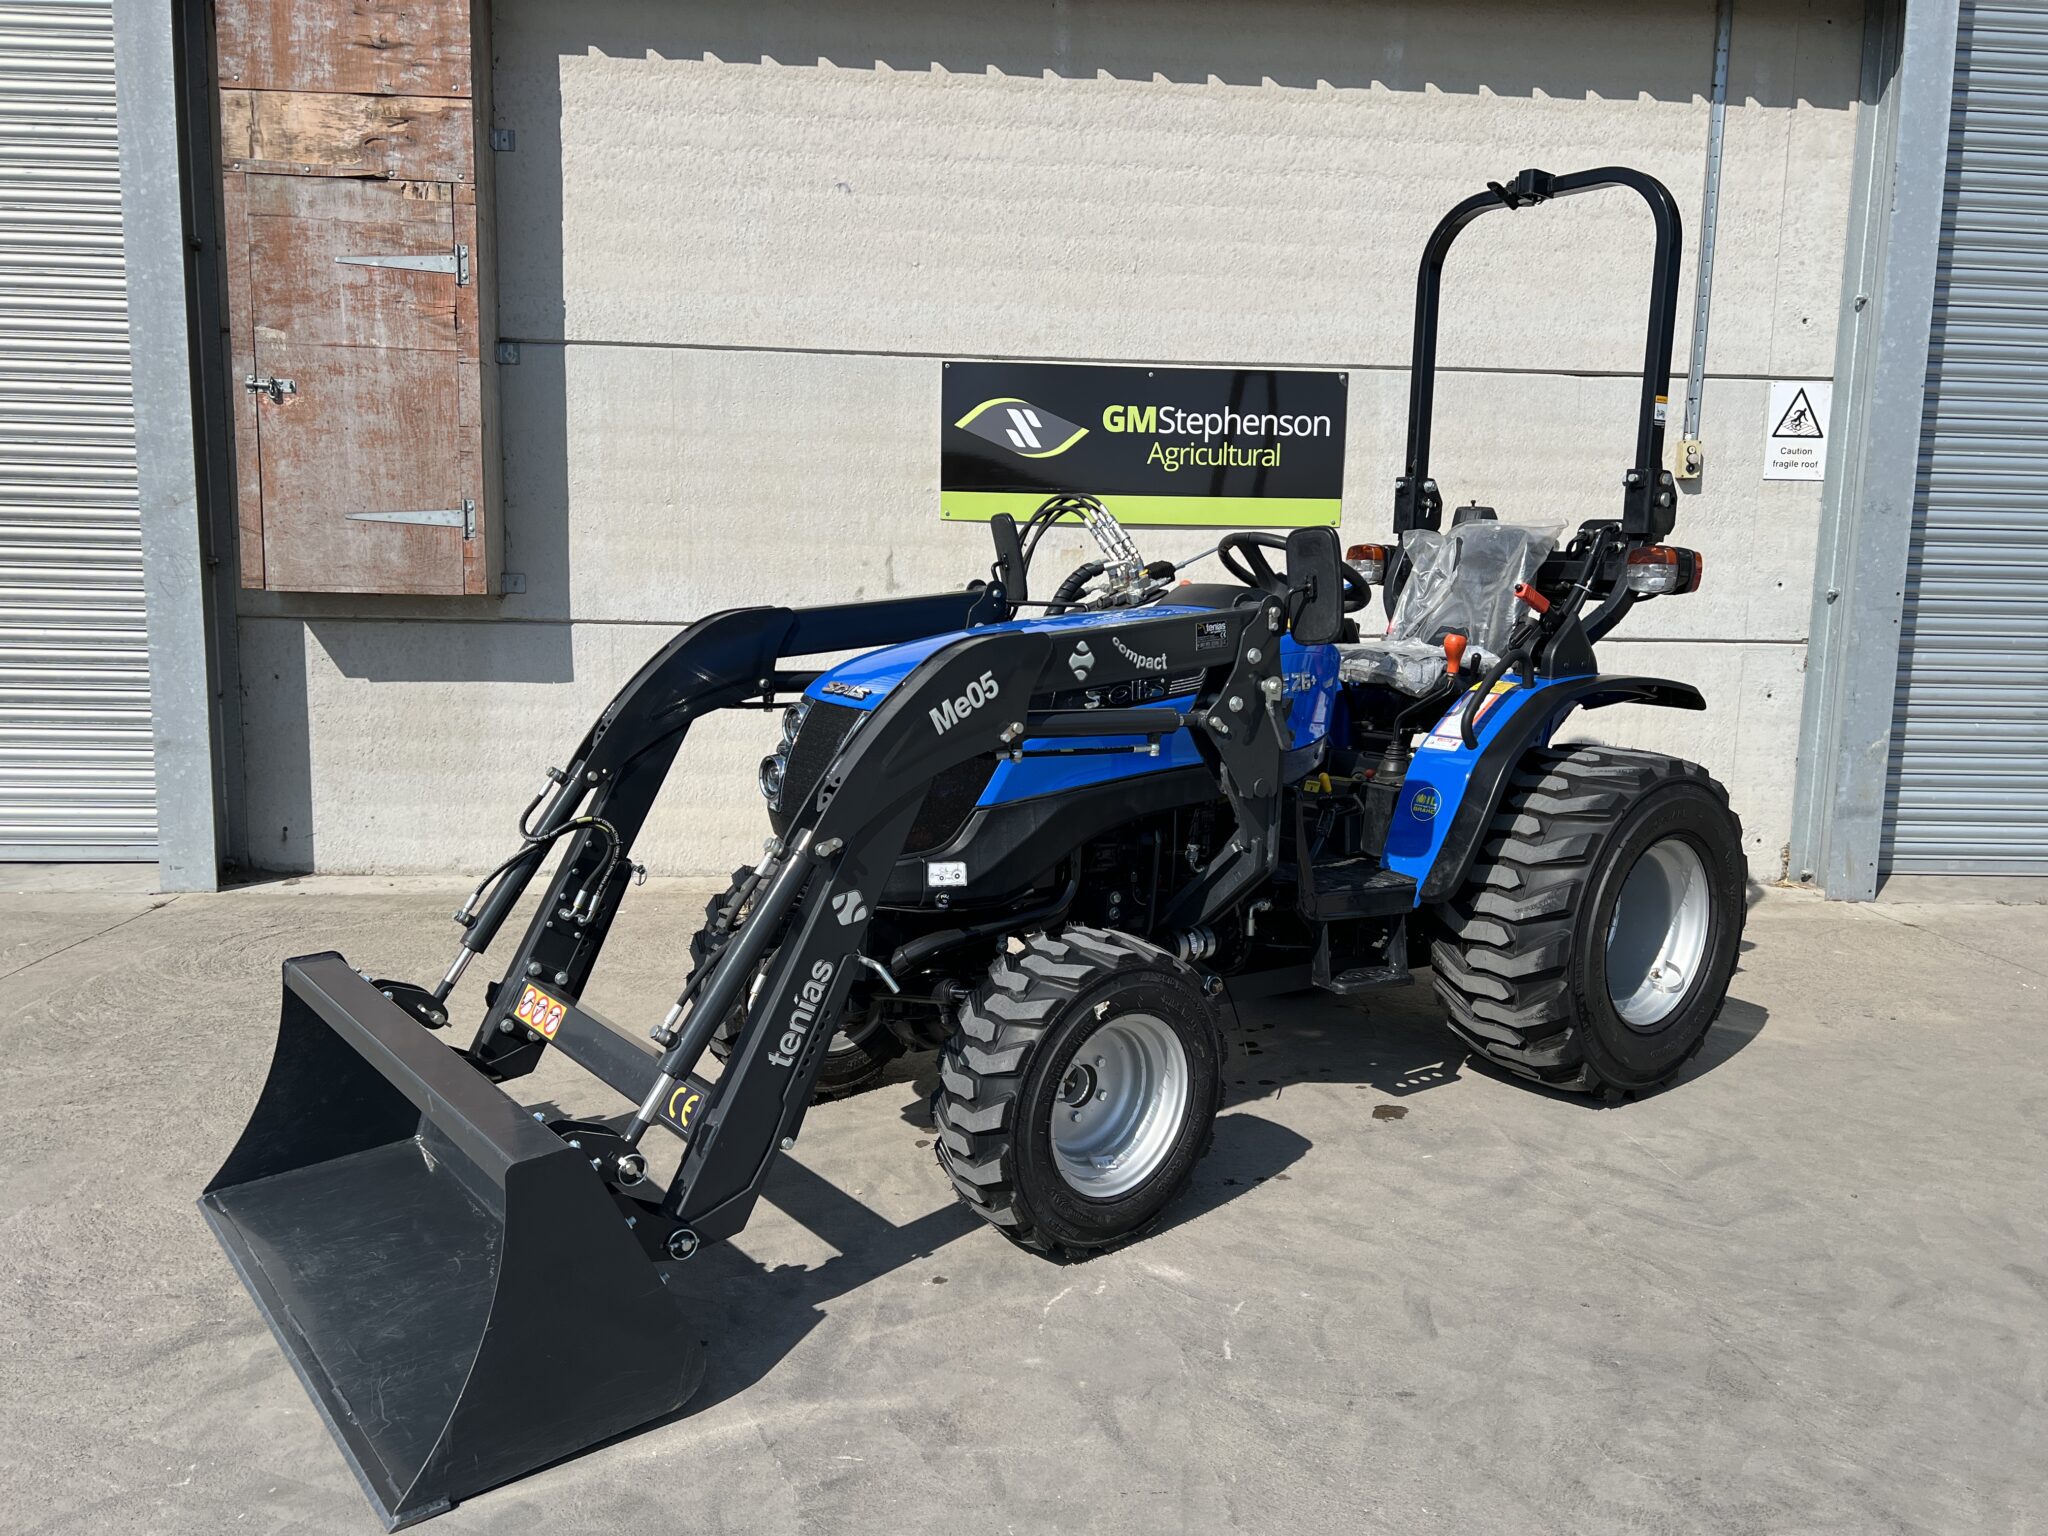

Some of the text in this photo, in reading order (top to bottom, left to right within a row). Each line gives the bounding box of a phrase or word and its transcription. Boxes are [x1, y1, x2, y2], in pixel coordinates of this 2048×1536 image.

[1147, 441, 1281, 472] Agricultural
[1772, 460, 1799, 470] fragile
[1780, 447, 1813, 455] Caution
[1112, 636, 1167, 670] compact
[929, 670, 999, 736] Me05
[669, 1086, 699, 1127] CE
